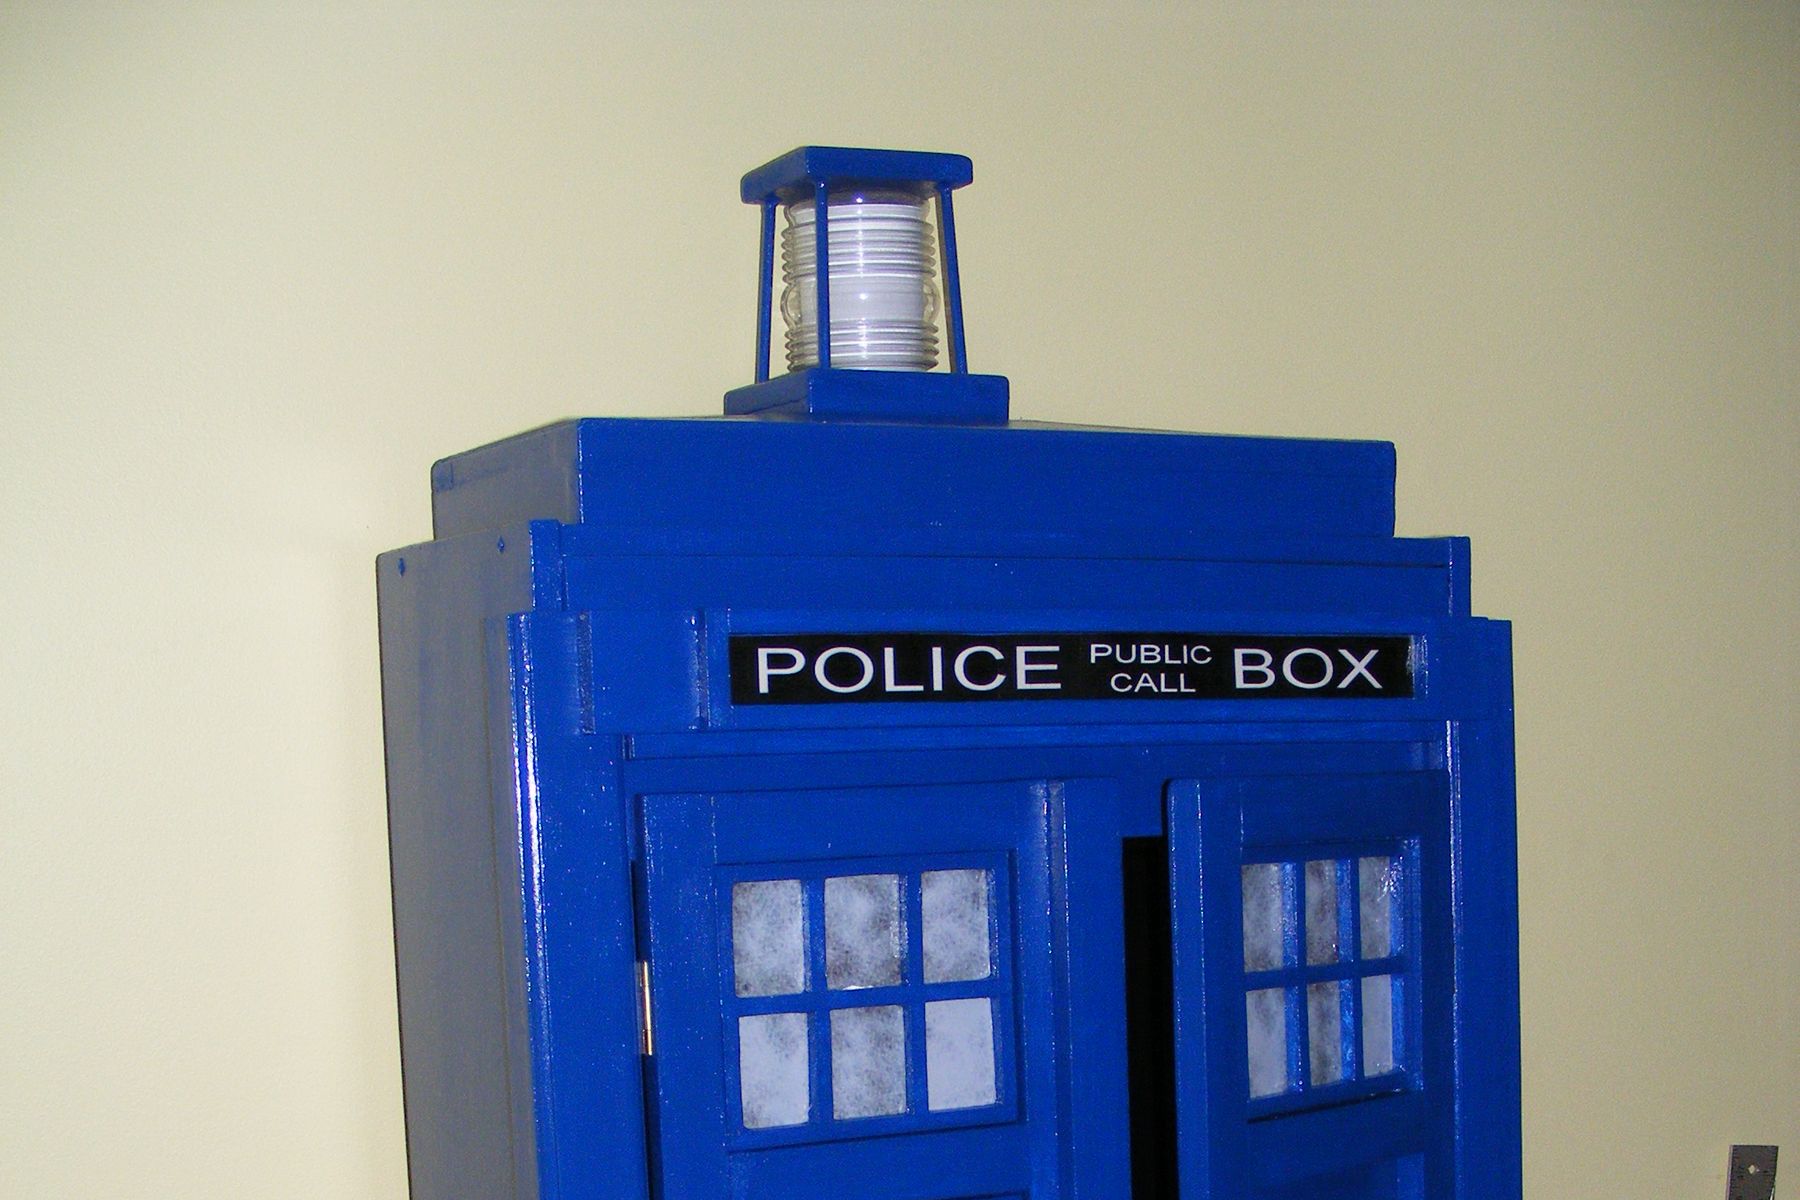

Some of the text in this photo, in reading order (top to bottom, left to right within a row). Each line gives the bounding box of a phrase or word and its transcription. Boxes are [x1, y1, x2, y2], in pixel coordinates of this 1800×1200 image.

[756, 643, 1384, 694] POLICE PUBLIC BOX
[1110, 671, 1197, 693] CALL
